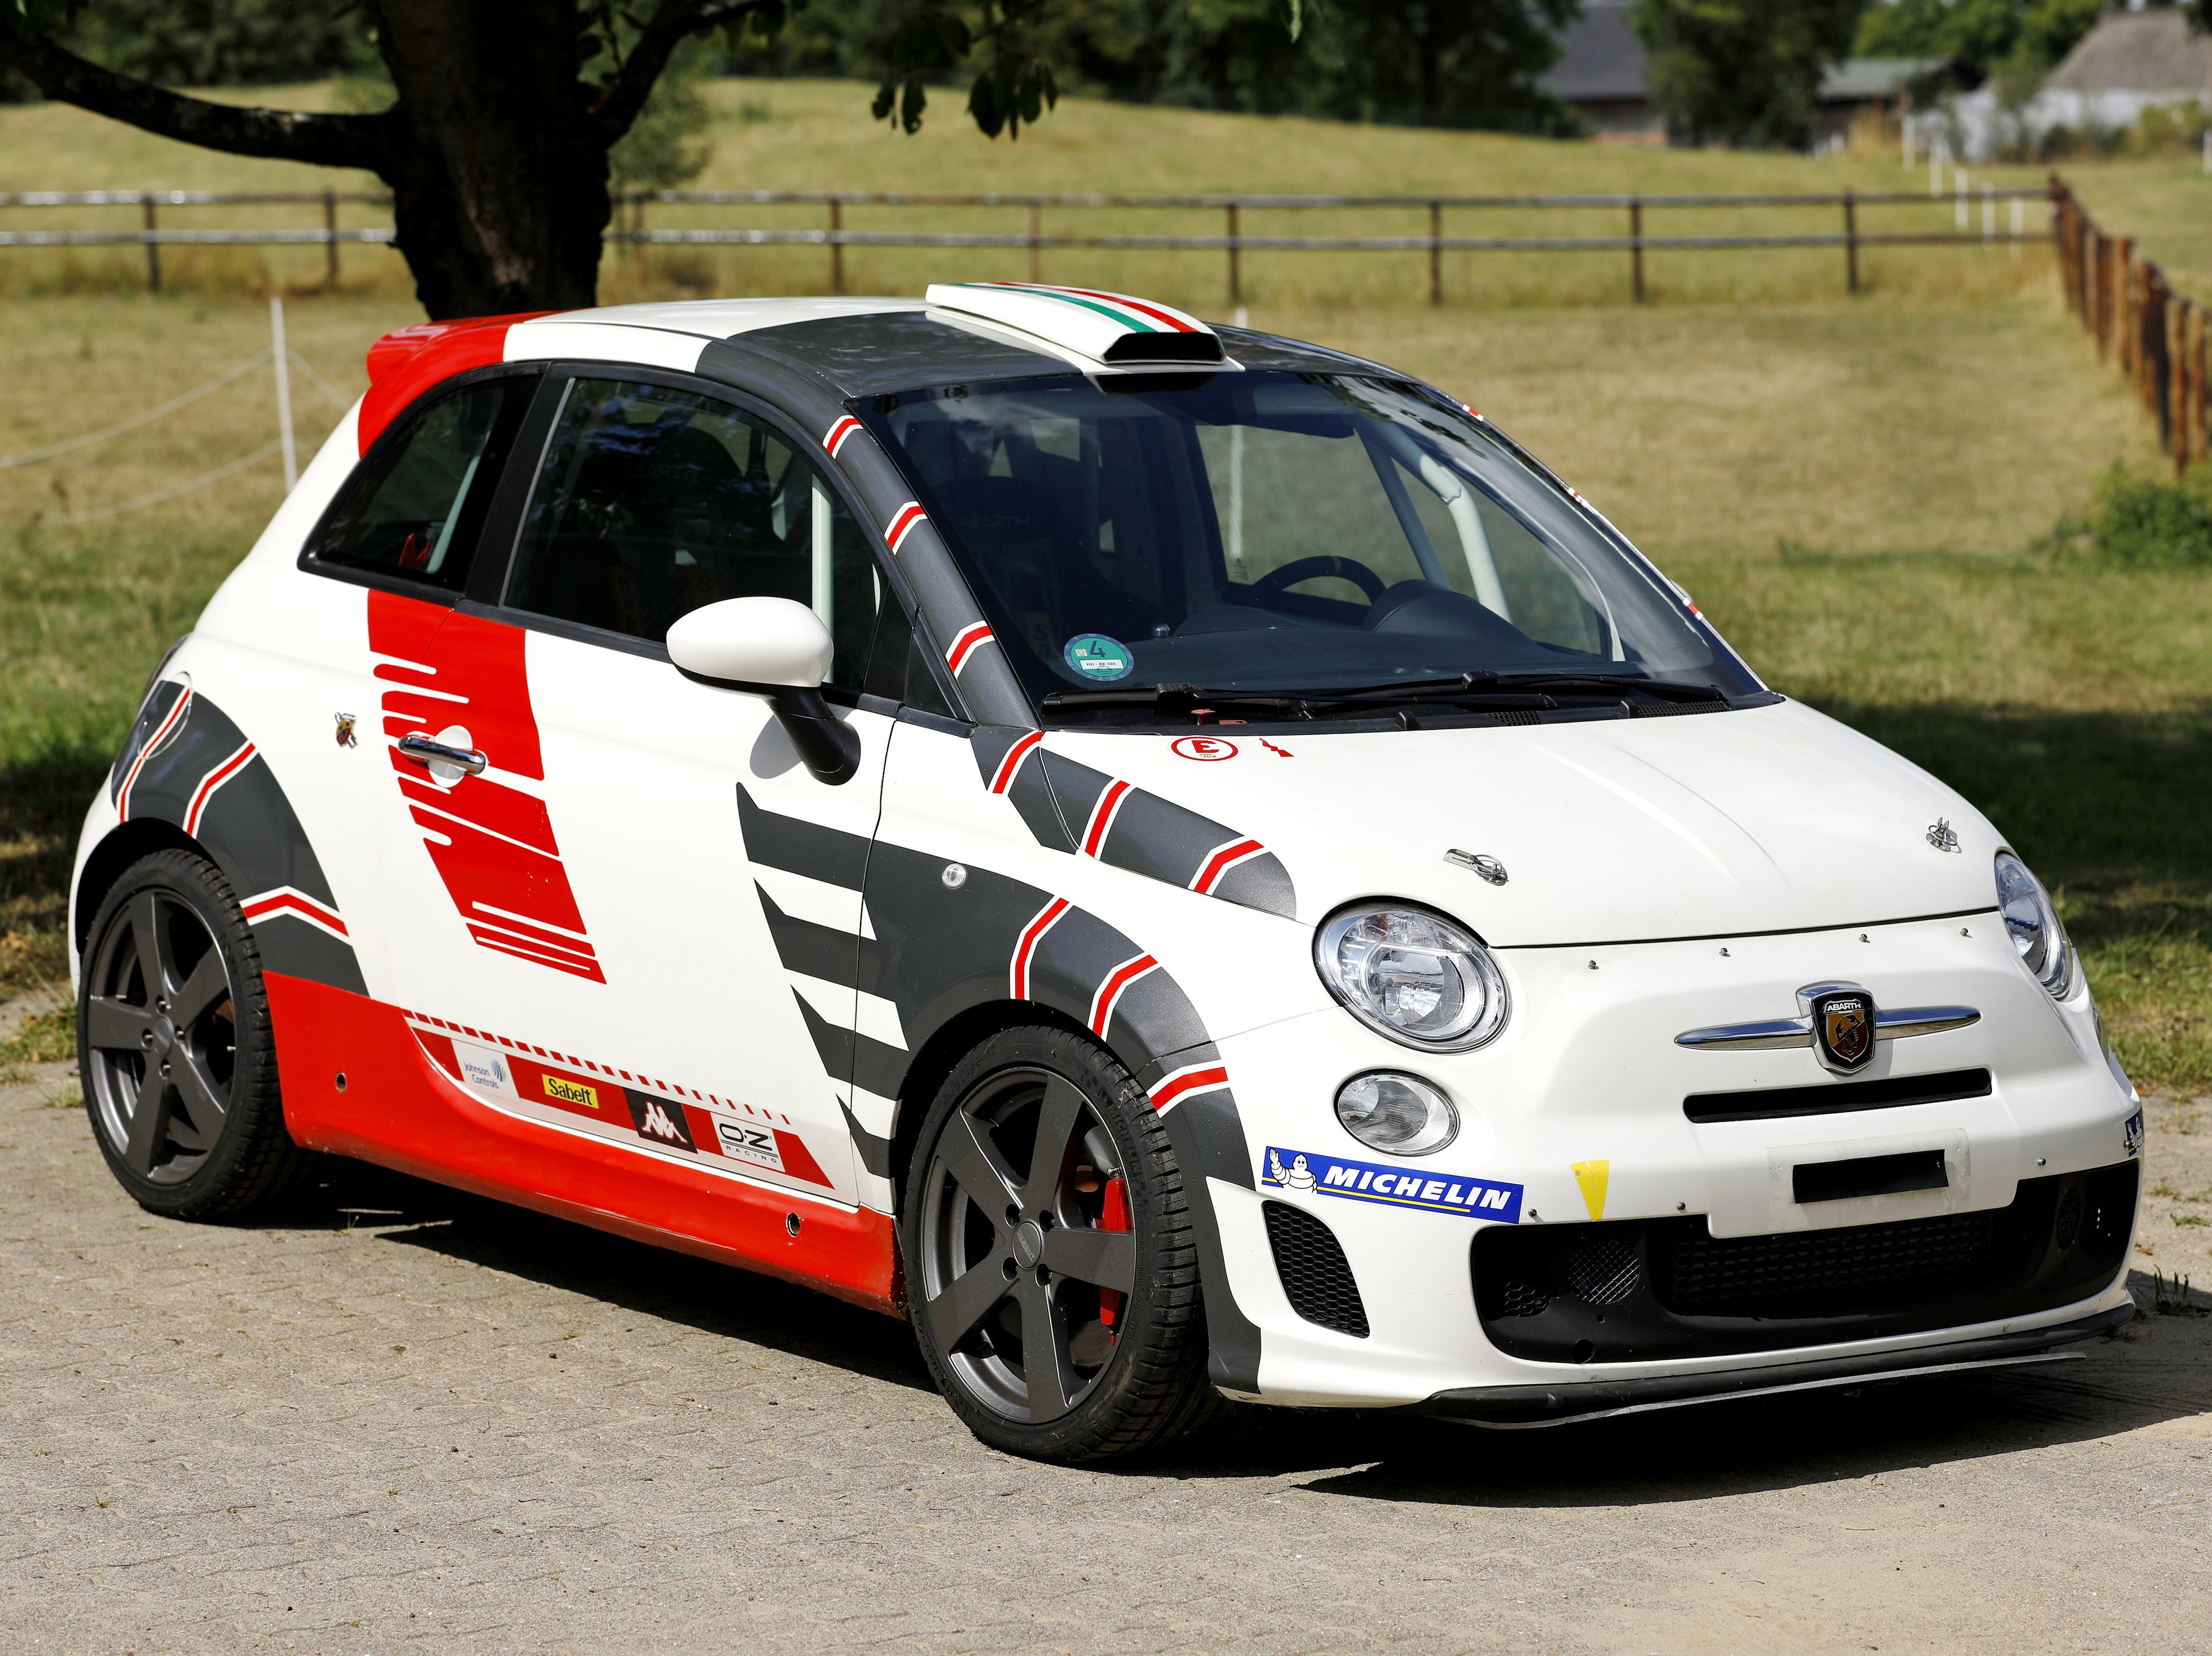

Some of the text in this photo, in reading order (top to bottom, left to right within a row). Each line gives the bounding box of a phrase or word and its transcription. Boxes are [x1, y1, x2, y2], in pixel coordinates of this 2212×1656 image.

[1090, 640, 1106, 658] 4
[1191, 740, 1220, 753] E
[1827, 1002, 1861, 1011] ABARTH
[463, 1061, 490, 1077] Johnson
[471, 1074, 500, 1090] Controls
[548, 1078, 593, 1106] Sabelt
[1107, 1103, 1142, 1174] MICHELIN
[726, 1145, 777, 1163] RACING
[1323, 1165, 1512, 1210] MICHELIN
[1017, 1228, 1036, 1259] DEZENT
